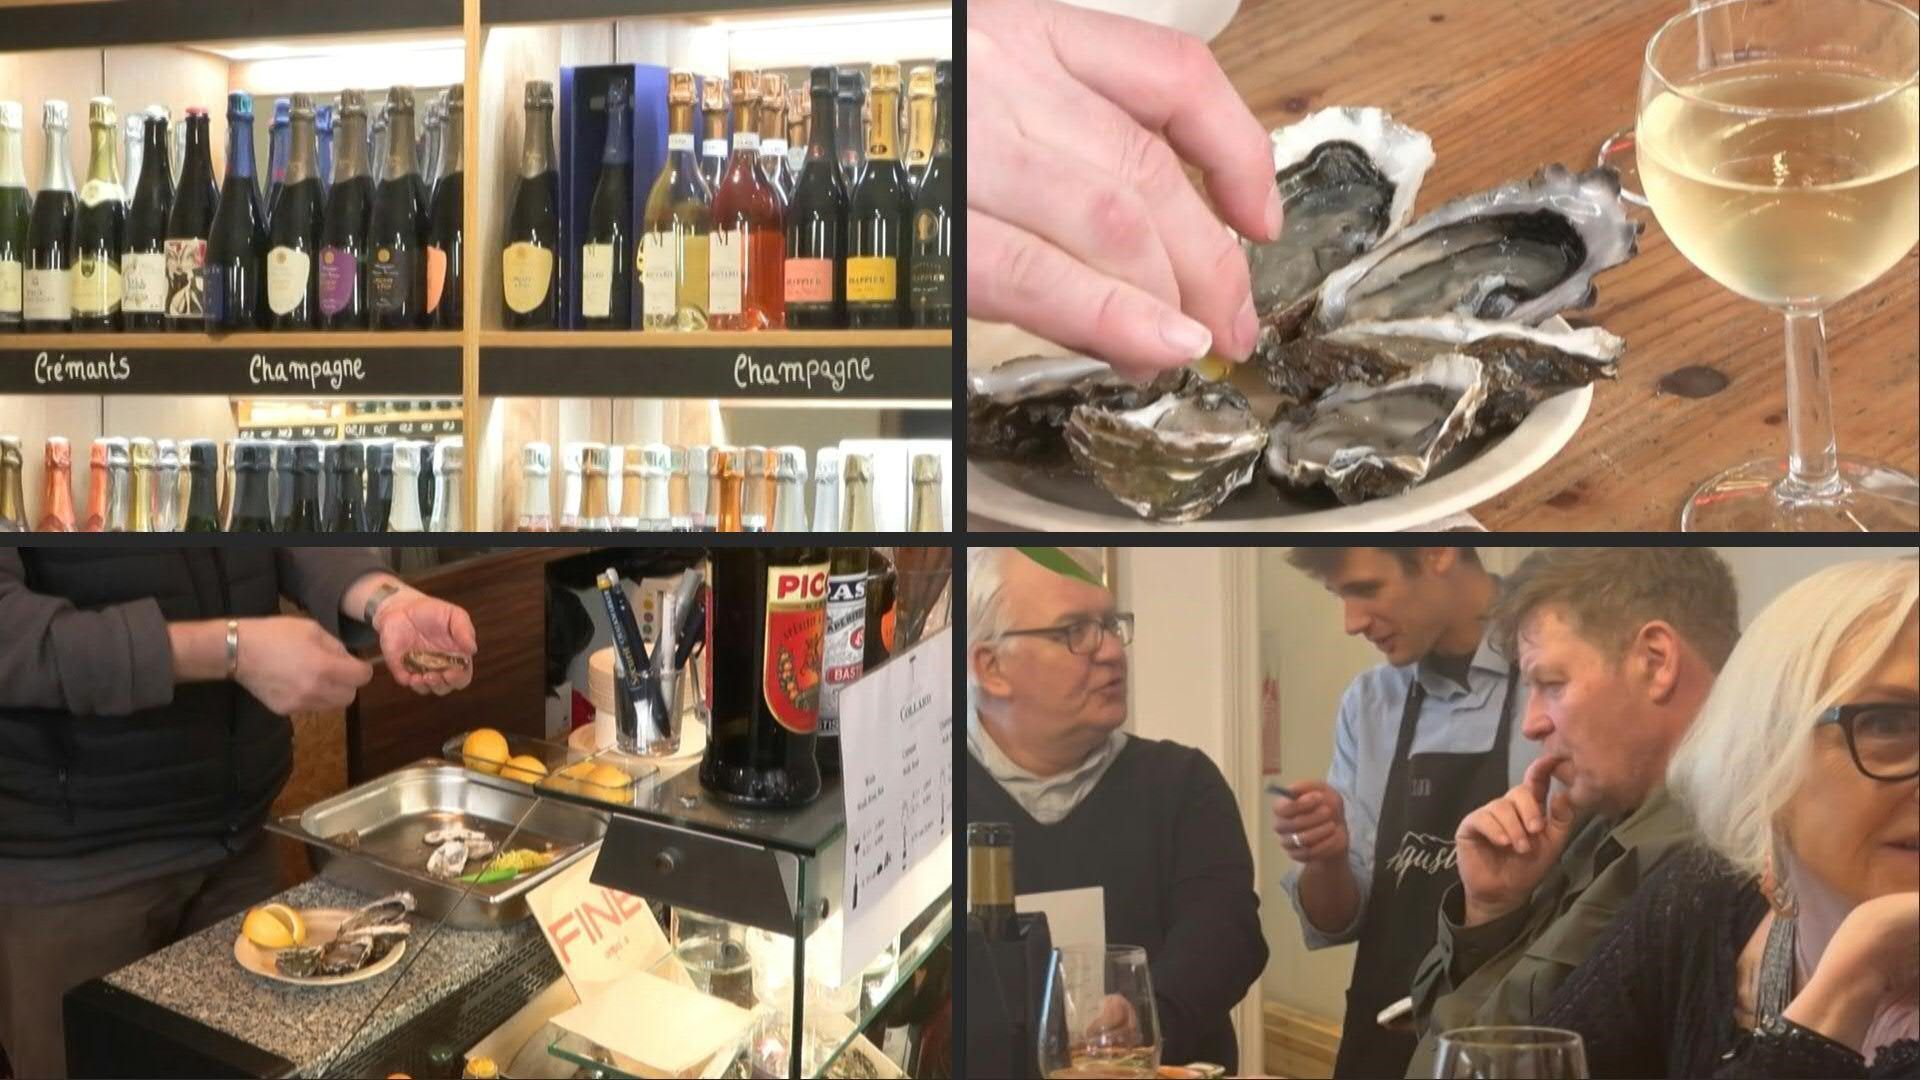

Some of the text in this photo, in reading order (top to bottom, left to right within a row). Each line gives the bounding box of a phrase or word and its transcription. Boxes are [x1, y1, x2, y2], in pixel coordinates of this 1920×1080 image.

[35, 351, 130, 383] Crémants
[249, 354, 366, 390] Champagne
[734, 352, 874, 391] Champagne
[777, 572, 829, 600] PIC
[547, 887, 643, 965] FINE
